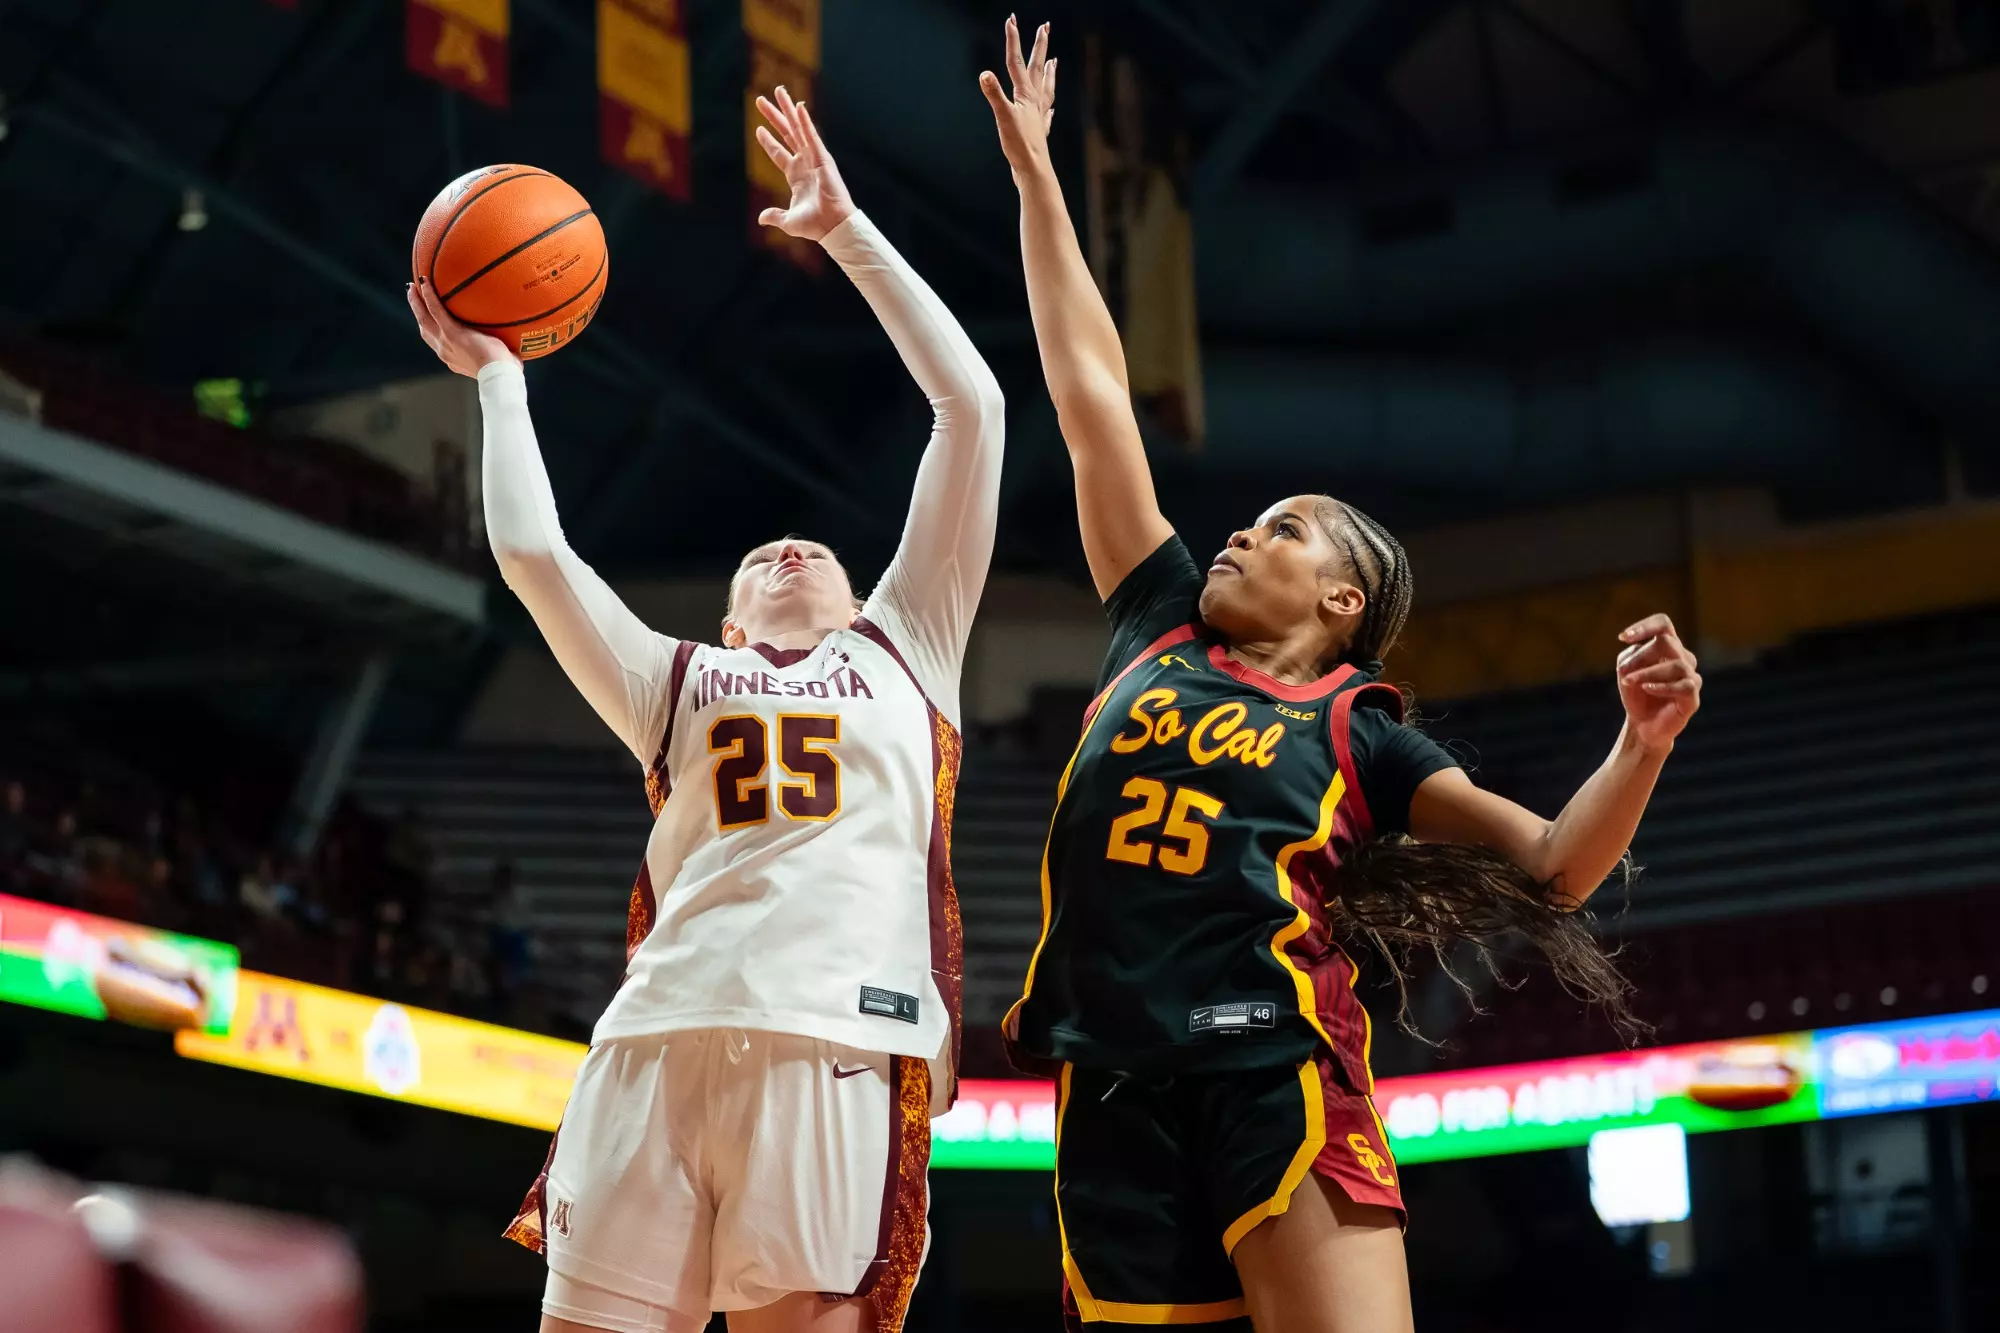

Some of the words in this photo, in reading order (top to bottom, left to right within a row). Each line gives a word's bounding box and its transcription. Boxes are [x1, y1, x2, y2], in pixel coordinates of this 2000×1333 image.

[1110, 688, 1187, 754] So
[1188, 702, 1286, 768] Cal
[707, 713, 842, 832] 25
[1105, 775, 1226, 877] 25
[904, 1001, 910, 1013] L
[1254, 1008, 1270, 1020] 46
[1347, 1133, 1396, 1187] SC
